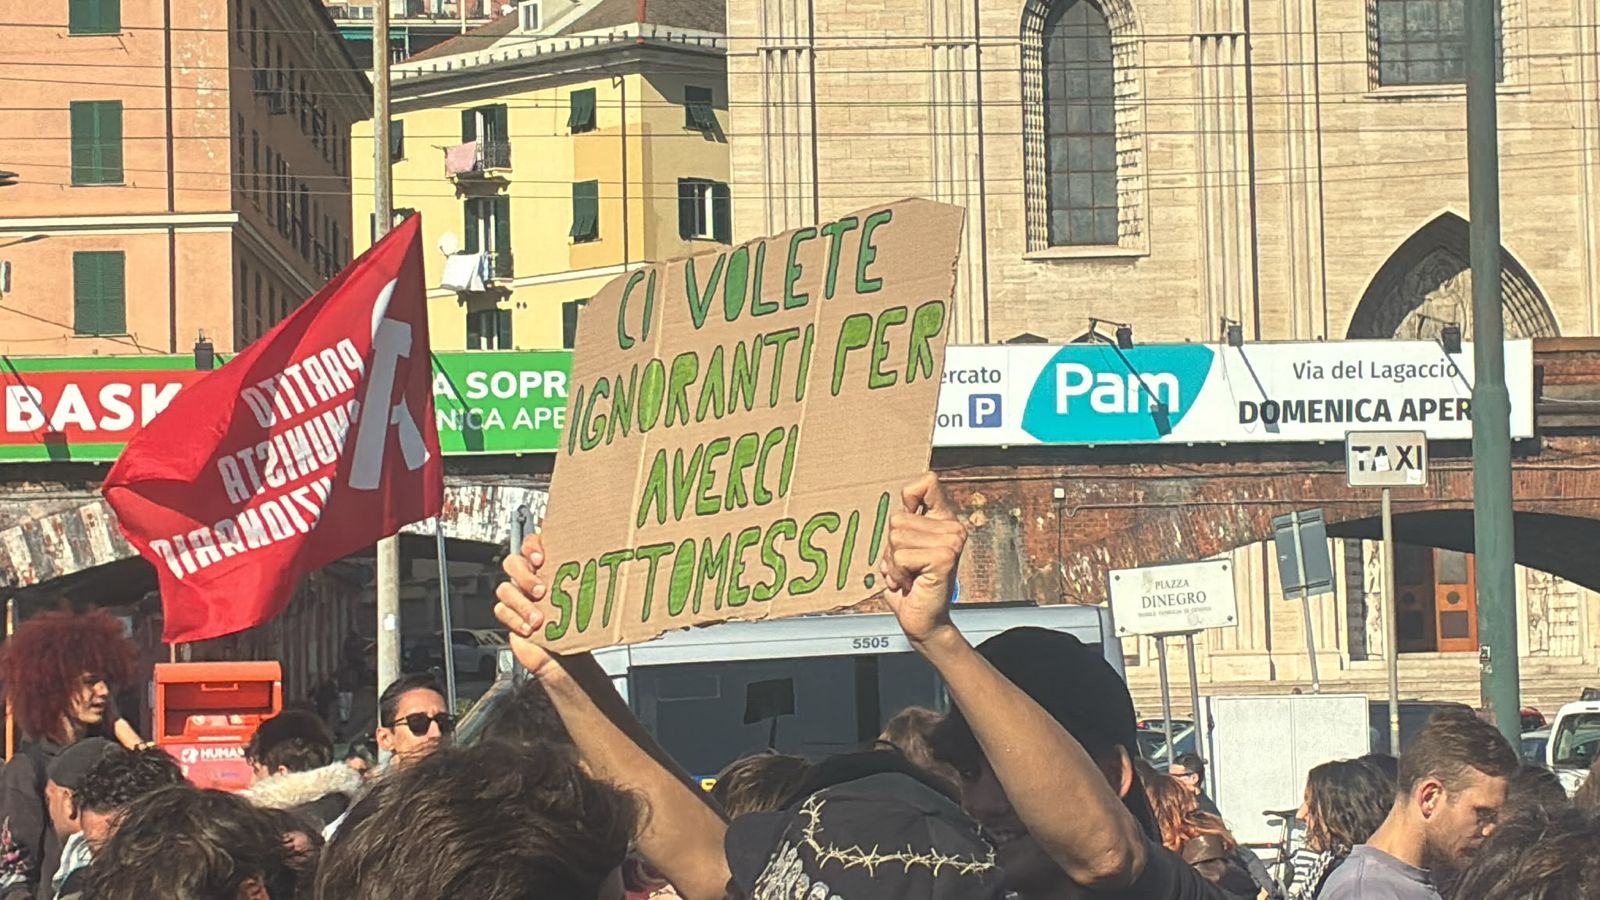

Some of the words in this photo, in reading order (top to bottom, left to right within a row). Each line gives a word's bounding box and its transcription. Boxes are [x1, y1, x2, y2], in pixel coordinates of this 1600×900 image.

[617, 268, 657, 350] CI
[685, 209, 893, 330] VOLETE
[568, 323, 815, 456] IGNORANTI
[831, 301, 946, 396] PER
[1293, 361, 1324, 380] Via
[1331, 360, 1363, 380] del
[1371, 358, 1458, 383] Lagaccio
[466, 371, 568, 399] SOPR
[1056, 362, 1180, 414] Pam
[1239, 399, 1392, 425] DOMENICA
[1351, 445, 1422, 472] TAXI
[637, 424, 798, 528] AVERCI
[545, 492, 890, 641] SOTTOMESSI!
[1155, 579, 1190, 590] PIAZZA
[1141, 591, 1207, 609] DINEGRO
[853, 637, 889, 649] 5505
